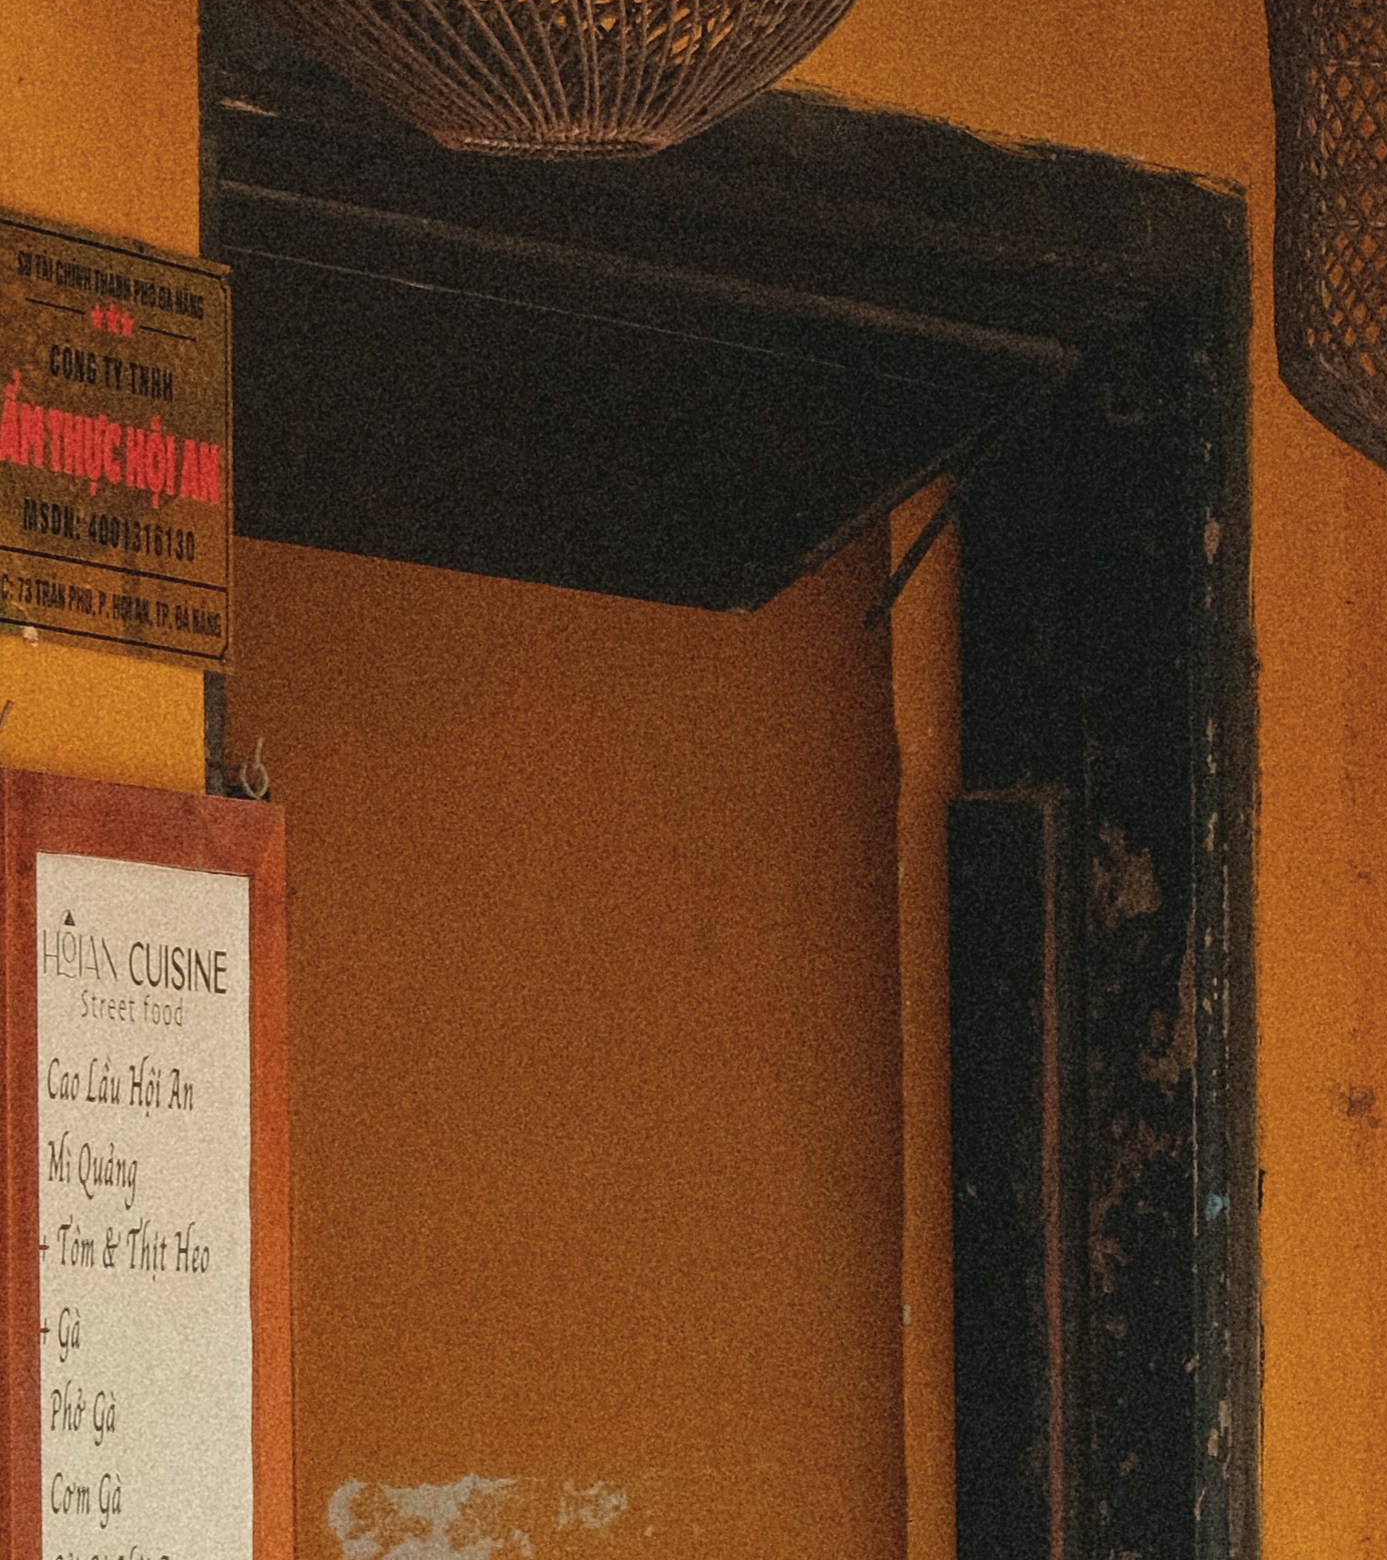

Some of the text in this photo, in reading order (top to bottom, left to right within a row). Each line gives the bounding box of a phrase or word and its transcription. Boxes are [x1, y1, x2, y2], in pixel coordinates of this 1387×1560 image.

[125, 414, 176, 510] HỘI
[179, 438, 222, 505] AN
[128, 941, 228, 995] CUISINE
[80, 990, 184, 1027] Street food
[47, 1054, 195, 1118] Cao Lầu Hội An
[77, 1142, 138, 1210] Quảng
[57, 1214, 96, 1269] Tôm
[126, 1216, 168, 1281] Thịt
[174, 1220, 211, 1274] Heo
[50, 1379, 117, 1447] Phở Gà
[50, 1471, 122, 1529] Cơm Gà
